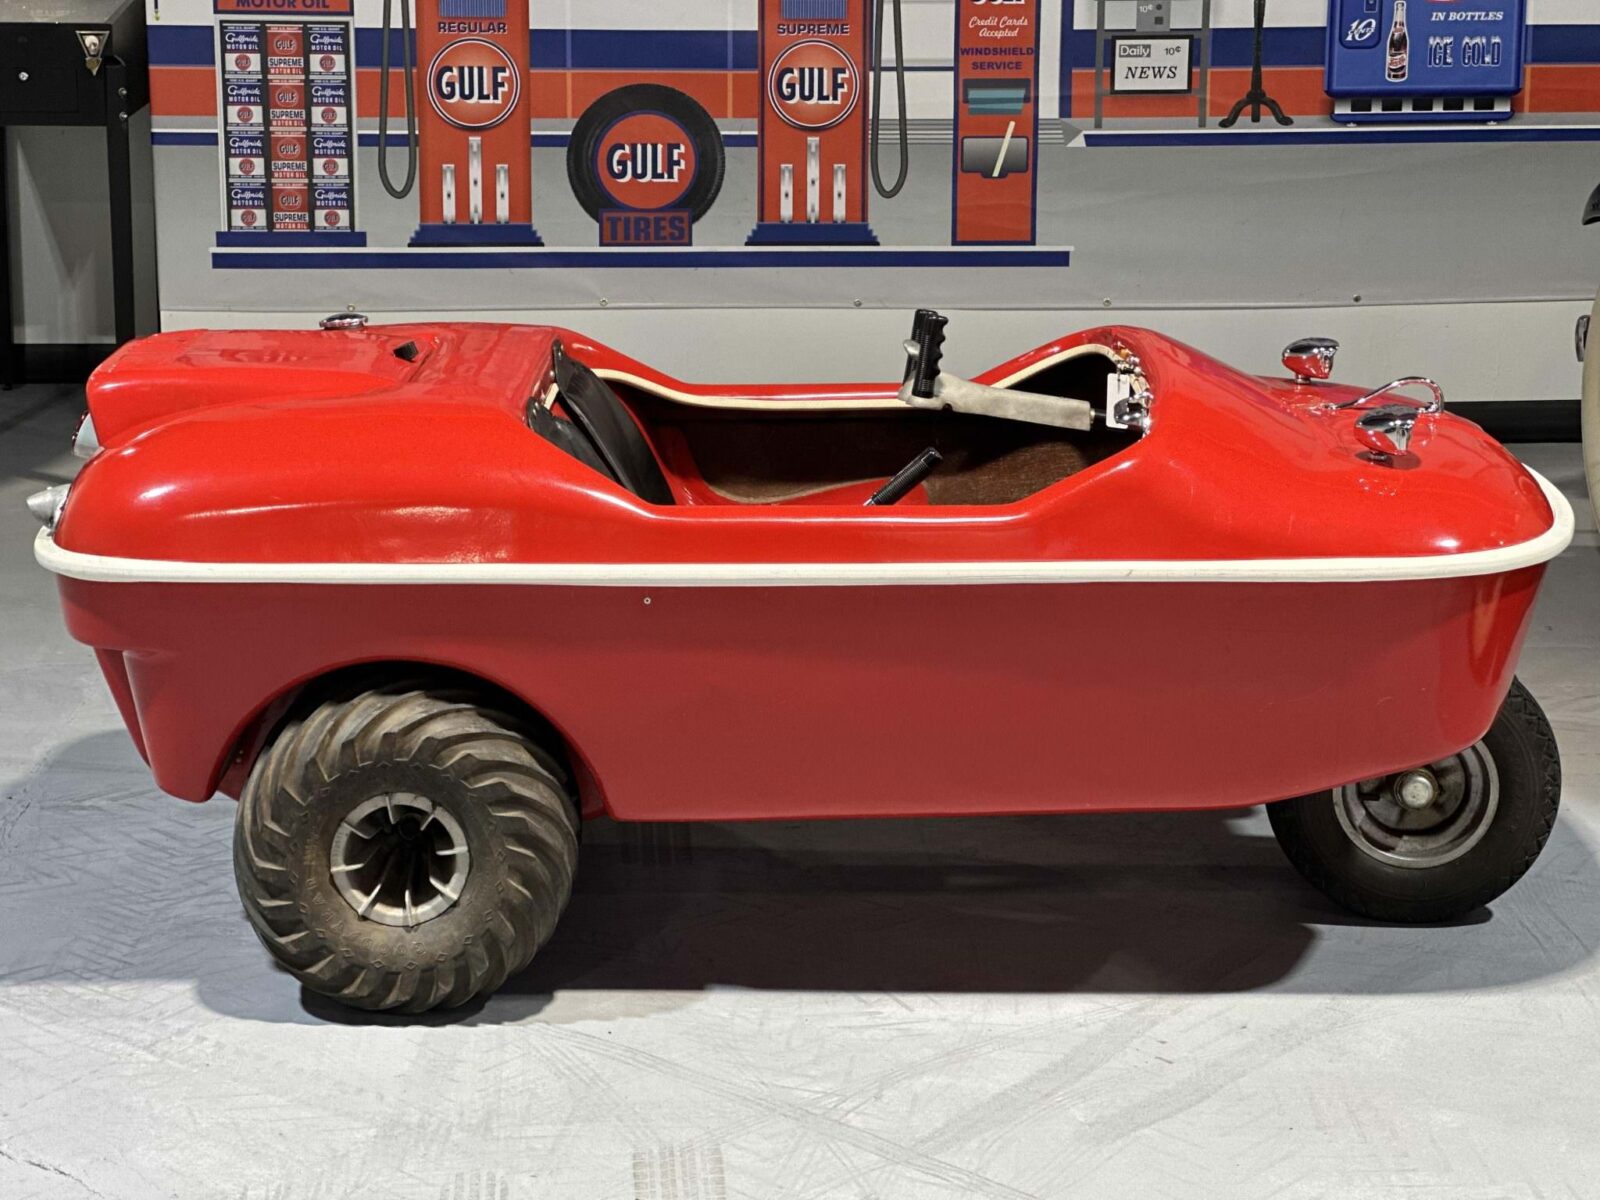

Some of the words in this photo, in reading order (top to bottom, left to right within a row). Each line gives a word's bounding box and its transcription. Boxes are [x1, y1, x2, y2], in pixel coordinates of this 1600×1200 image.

[236, 0, 296, 8] MOTOR
[303, 0, 330, 9] OIL
[968, 16, 998, 28] Credit
[999, 16, 1028, 28] Cards
[1430, 11, 1446, 21] IN
[1447, 11, 1504, 21] BOTTLES
[437, 21, 508, 34] REGULAR
[777, 23, 850, 36] SUPREME
[978, 27, 1020, 40] Accepted
[275, 40, 295, 50] GULF
[1120, 45, 1150, 57] Daily
[1163, 45, 1182, 56] 10¢
[960, 47, 1034, 56] WINDSHIELD
[1427, 35, 1454, 68] ICE
[1462, 35, 1502, 68] COLD
[269, 58, 303, 66] SUPREME
[971, 61, 1023, 70] SERVICE
[1124, 66, 1178, 79] NEWS
[436, 65, 510, 104] GULF
[777, 67, 850, 105] GULF
[277, 91, 297, 103] GULF
[271, 110, 304, 119] SUPREME
[279, 143, 299, 154] GULF
[273, 162, 306, 170] SUPREME
[606, 142, 686, 183] GULF
[280, 194, 300, 206] GULF
[274, 213, 307, 222] SUPREME
[606, 215, 686, 241] TIRES
